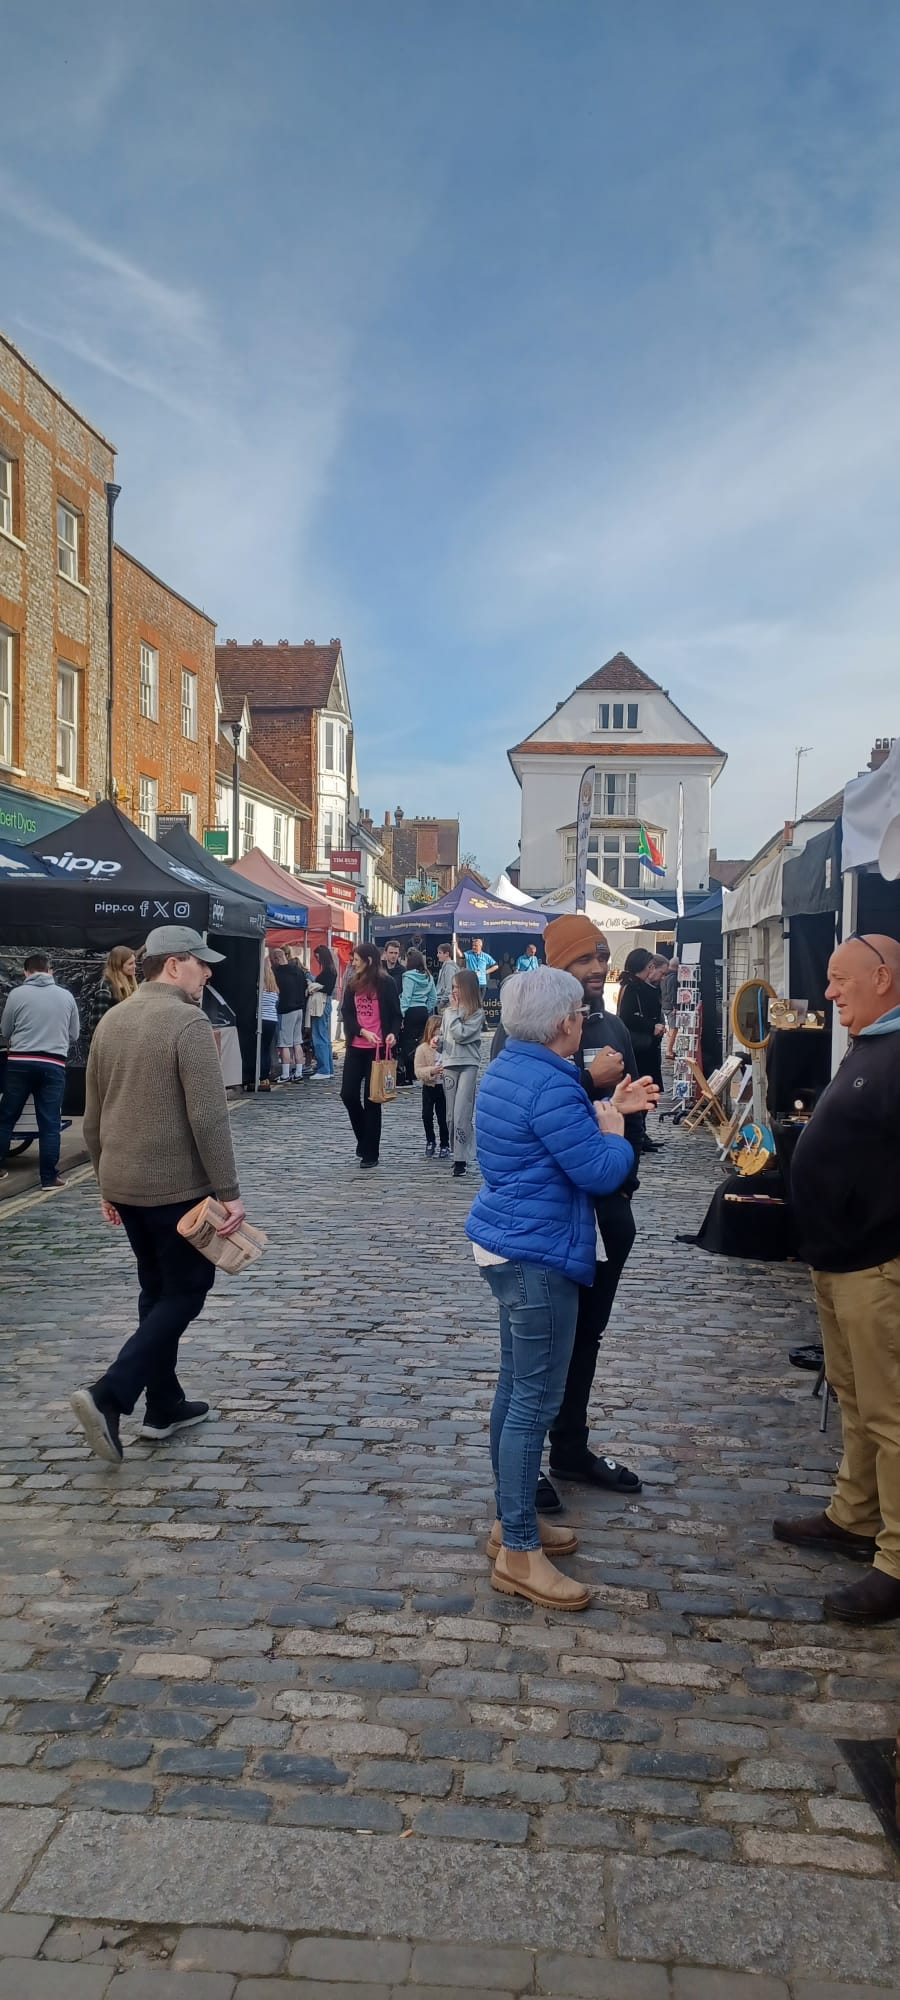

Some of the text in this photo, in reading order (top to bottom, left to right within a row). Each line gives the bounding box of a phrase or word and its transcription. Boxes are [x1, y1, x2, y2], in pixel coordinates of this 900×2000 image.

[0, 808, 36, 834] bert Dyas
[94, 901, 135, 913] pipp.co
[484, 998, 503, 1007] uide
[484, 1009, 500, 1018] ogs
